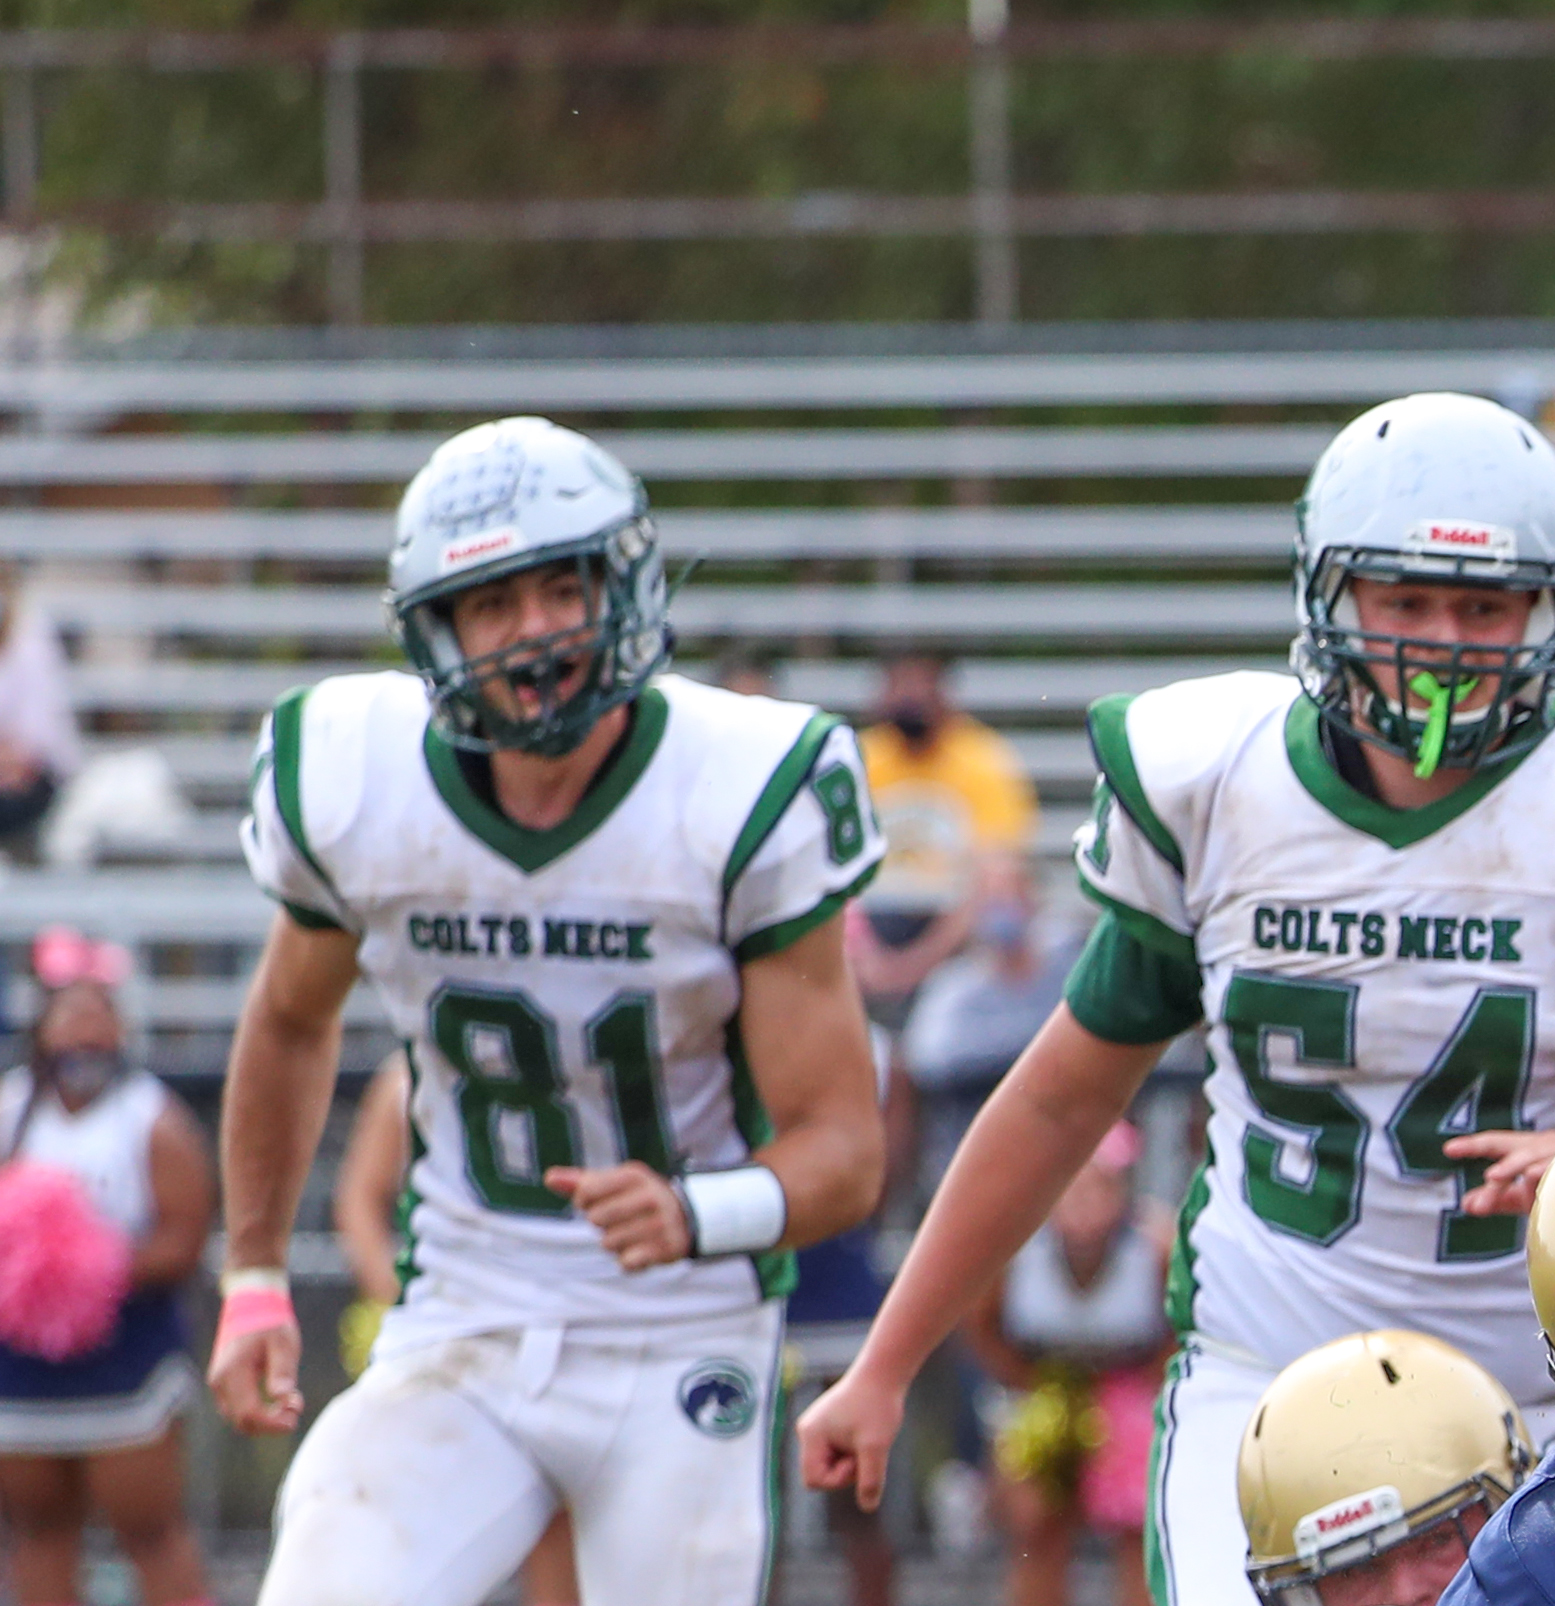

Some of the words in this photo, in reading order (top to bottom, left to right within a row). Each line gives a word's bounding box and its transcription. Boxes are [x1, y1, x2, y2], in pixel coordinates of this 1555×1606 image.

[1429, 526, 1489, 546] Riddell
[1253, 906, 1386, 959] COLTS
[1397, 914, 1523, 963] NECK
[427, 975, 680, 1220] 81
[1220, 967, 1539, 1264] 54
[1316, 1499, 1374, 1533] Riddell
